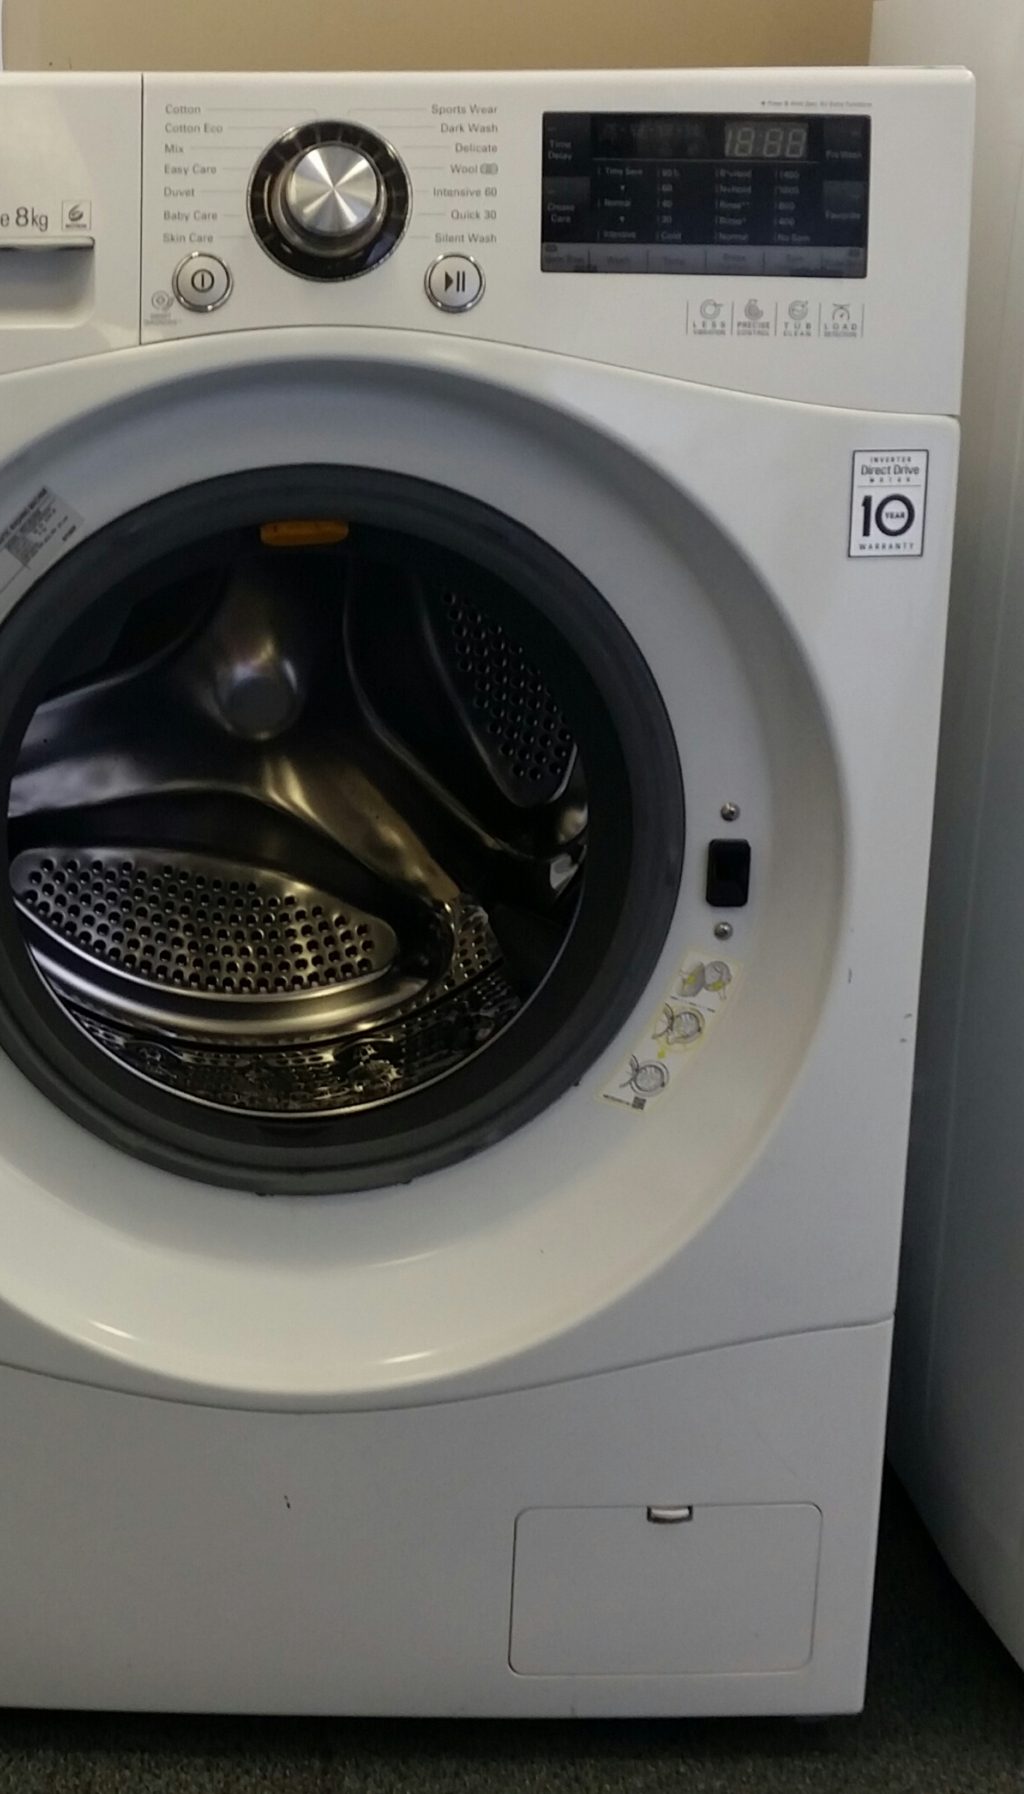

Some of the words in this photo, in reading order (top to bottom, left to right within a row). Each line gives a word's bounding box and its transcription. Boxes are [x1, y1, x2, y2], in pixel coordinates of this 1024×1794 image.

[165, 104, 201, 114] Cotton
[431, 104, 466, 116] Sports
[469, 104, 497, 114] Wear
[165, 123, 201, 133] Cotton
[203, 122, 223, 133] Eco
[440, 122, 465, 133] Dark
[468, 122, 498, 133] Wash
[164, 143, 184, 153] Mix
[455, 142, 498, 153] Delicate
[164, 163, 189, 175] Easy
[192, 163, 217, 174] Care
[449, 163, 478, 174] Wool
[163, 186, 195, 197] Duvet
[433, 186, 481, 197] Intensive
[15, 206, 49, 232] 8kg
[163, 210, 190, 221] Baby
[193, 210, 218, 221] Care
[450, 209, 480, 220] Quick
[484, 209, 497, 220] 30
[163, 232, 186, 244] Skin
[189, 232, 214, 243] Care
[434, 232, 465, 243] Silent
[468, 232, 497, 243] Wash
[861, 464, 892, 475] Direct
[893, 464, 920, 475] Drive
[861, 493, 915, 537] 10
[858, 543, 914, 551] WARRANTY
